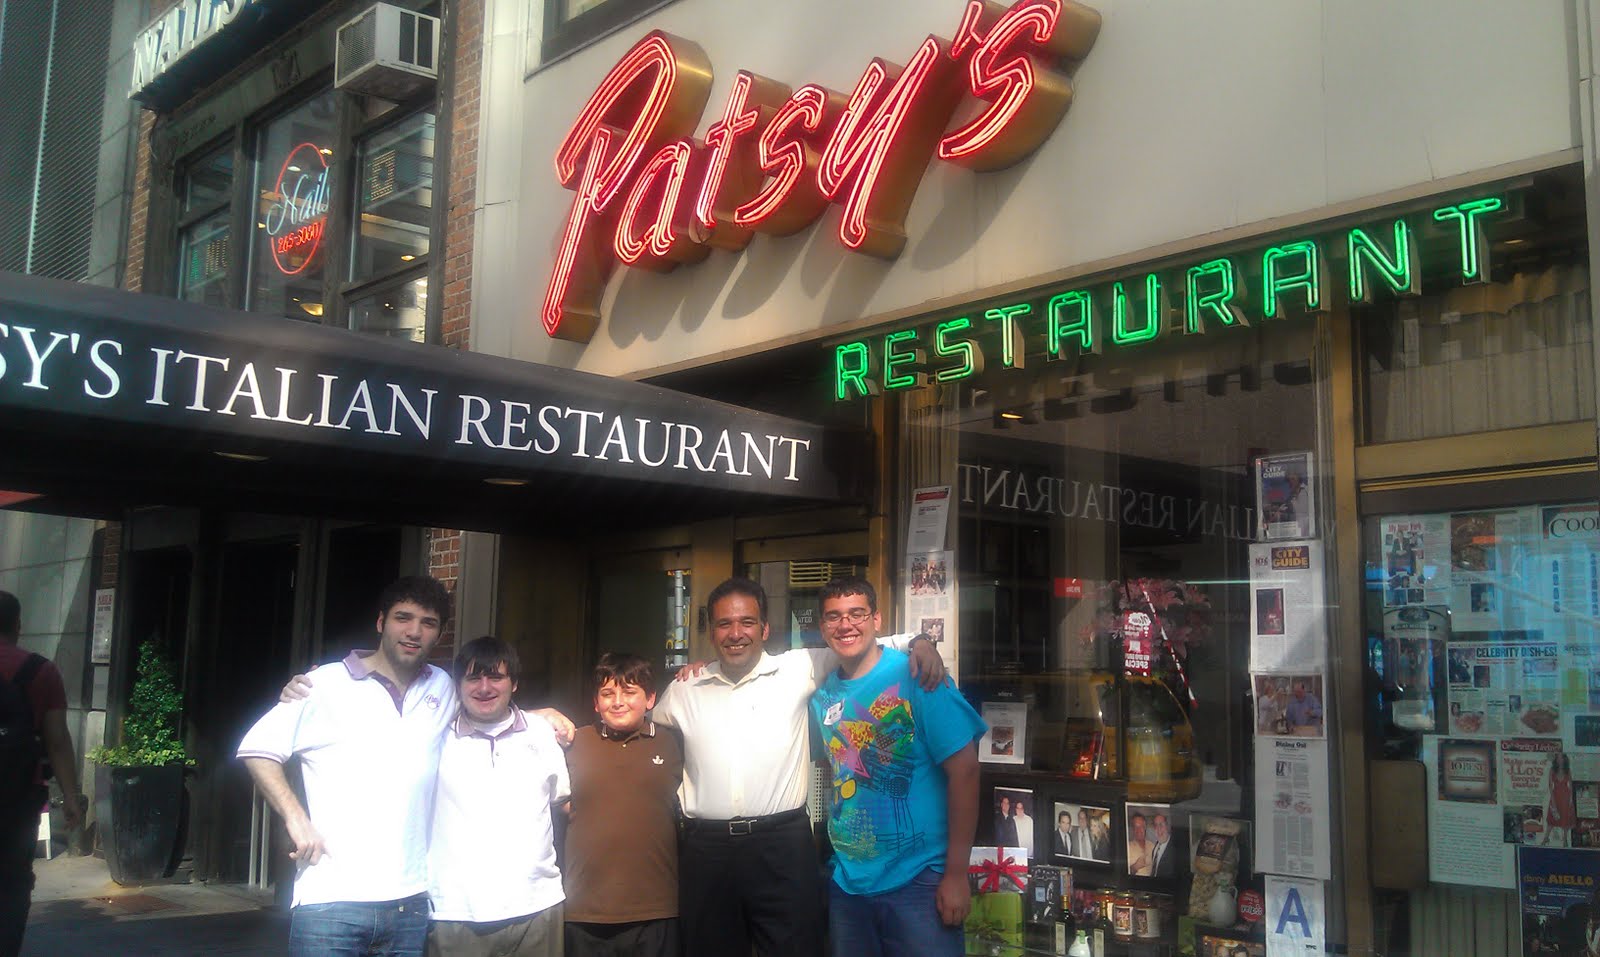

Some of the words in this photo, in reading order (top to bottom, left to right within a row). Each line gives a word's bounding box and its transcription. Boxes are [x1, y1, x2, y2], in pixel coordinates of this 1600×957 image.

[541, 0, 1063, 337] Patsy's
[266, 166, 331, 236] Nails
[834, 197, 1504, 402] RESTAURANT
[146, 346, 439, 441] ITALIAN
[458, 393, 812, 483] RESTAURANT
[1272, 557, 1309, 567] GUIDE
[1276, 549, 1301, 558] CITY
[1476, 647, 1519, 658] CELEBRITY
[1548, 875, 1594, 886] AIELLO
[1275, 887, 1312, 938] A
